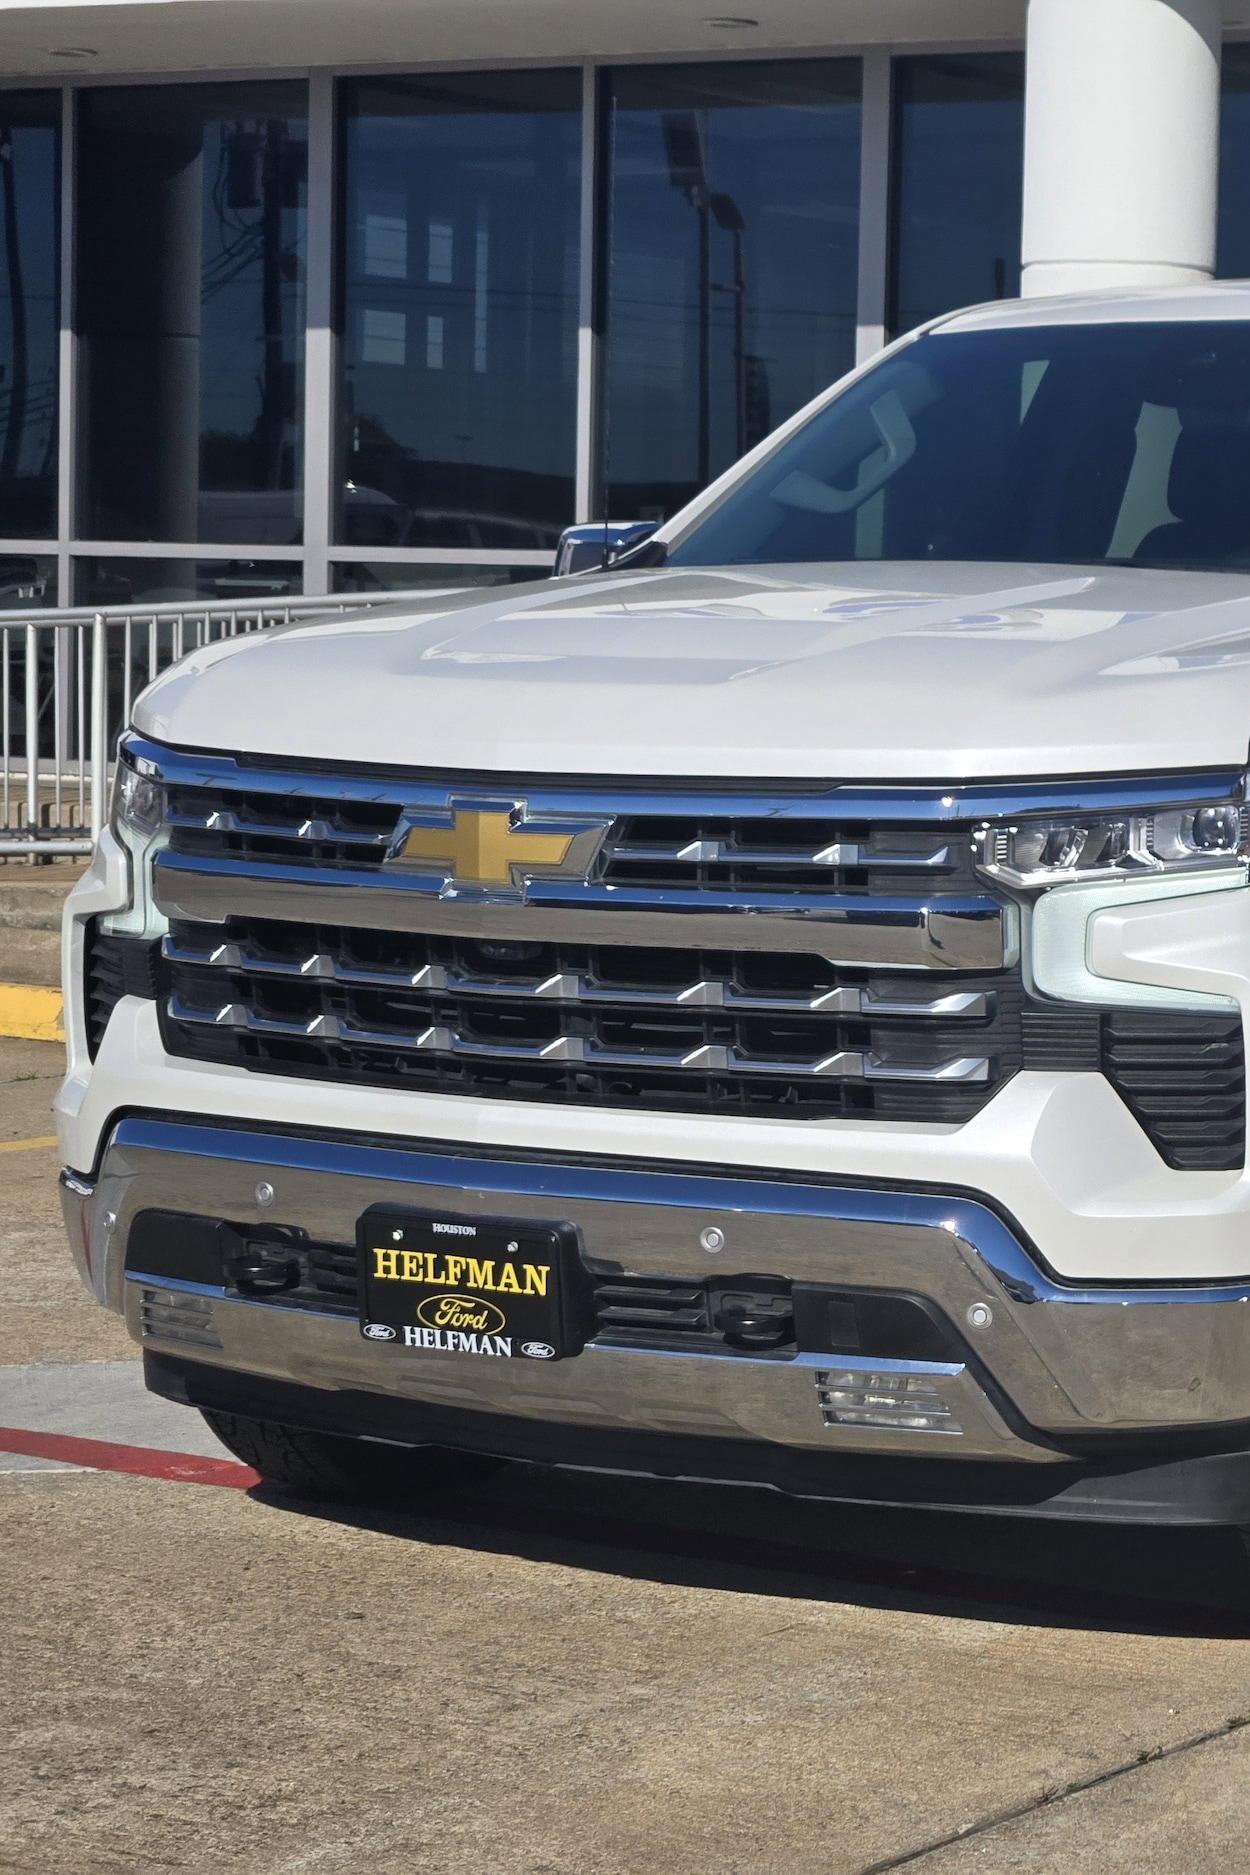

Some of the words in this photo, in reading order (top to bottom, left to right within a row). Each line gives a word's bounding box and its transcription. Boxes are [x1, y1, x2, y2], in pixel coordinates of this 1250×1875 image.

[432, 1222, 476, 1236] HOUSTON
[373, 1248, 550, 1296] HELFMAN
[435, 1297, 488, 1330] Ford
[369, 1326, 390, 1338] Ford
[403, 1326, 513, 1358] HELFMAN
[527, 1344, 549, 1357] Ford
